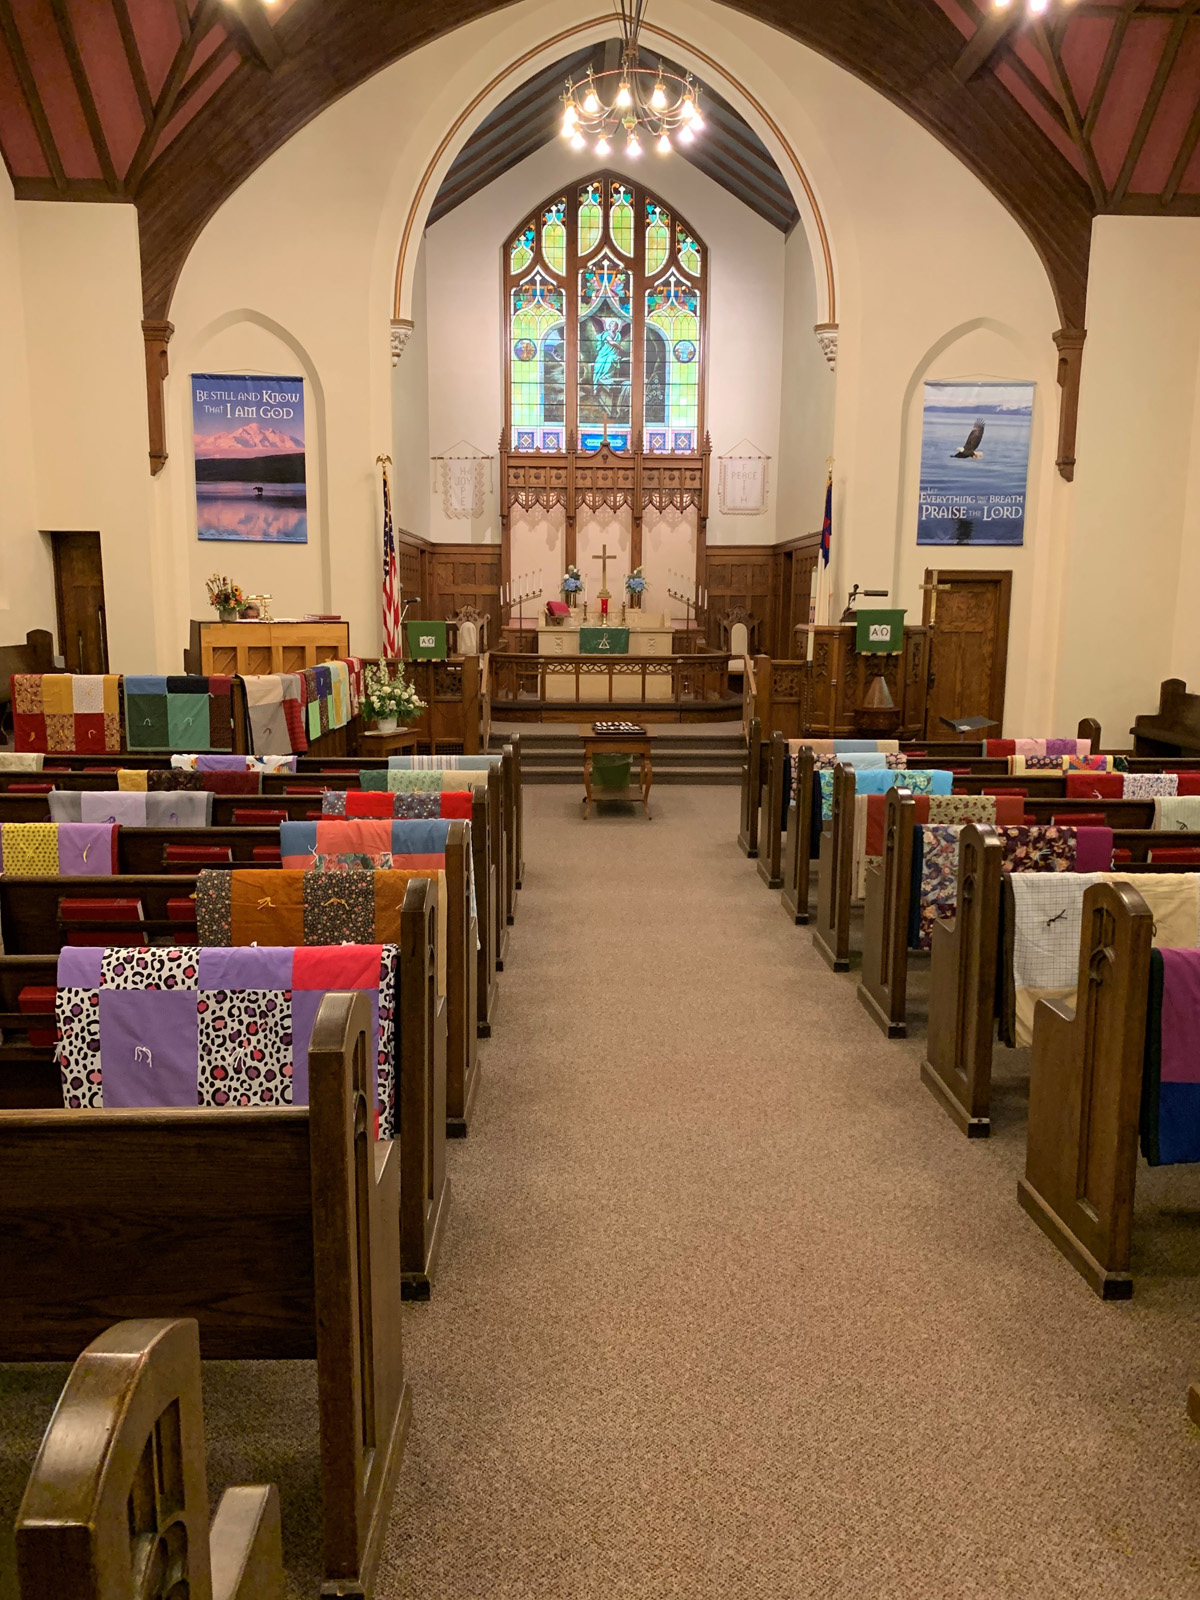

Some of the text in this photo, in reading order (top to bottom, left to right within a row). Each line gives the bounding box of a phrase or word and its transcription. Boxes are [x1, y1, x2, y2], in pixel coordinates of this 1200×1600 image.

[196, 389, 300, 404] BE STILL AND KNOW
[203, 403, 294, 419] THAT I AM GOD
[454, 476, 473, 486] JOY
[731, 471, 758, 480] PEACE
[920, 492, 976, 504] EVERYTHING
[989, 494, 1024, 504] BREATH
[921, 504, 968, 520] PRAISE
[982, 505, 1023, 521] LORD
